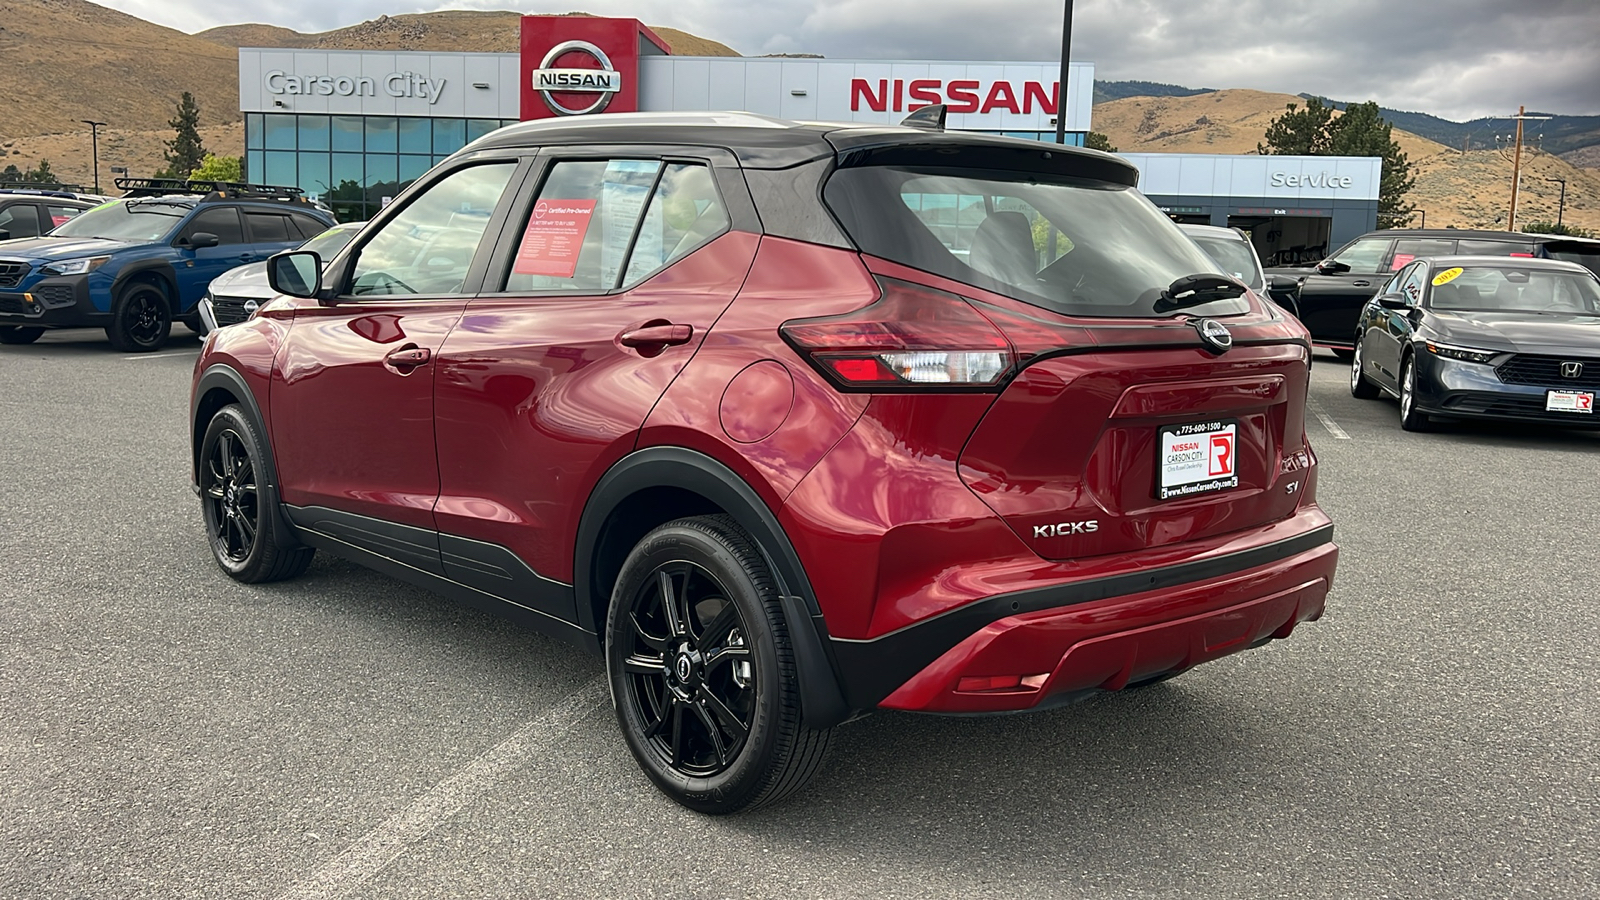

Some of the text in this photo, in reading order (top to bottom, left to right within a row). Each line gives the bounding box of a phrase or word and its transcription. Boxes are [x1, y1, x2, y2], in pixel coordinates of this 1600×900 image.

[264, 69, 447, 105] Carson City
[540, 73, 611, 87] NISSAN
[850, 78, 1060, 115] NISSAN
[1271, 171, 1352, 188] Service
[1181, 422, 1221, 434] 775-600-1500
[1171, 442, 1200, 453] NISSAN
[1167, 451, 1204, 464] CARSON CITY
[1033, 520, 1099, 538] KICKS
